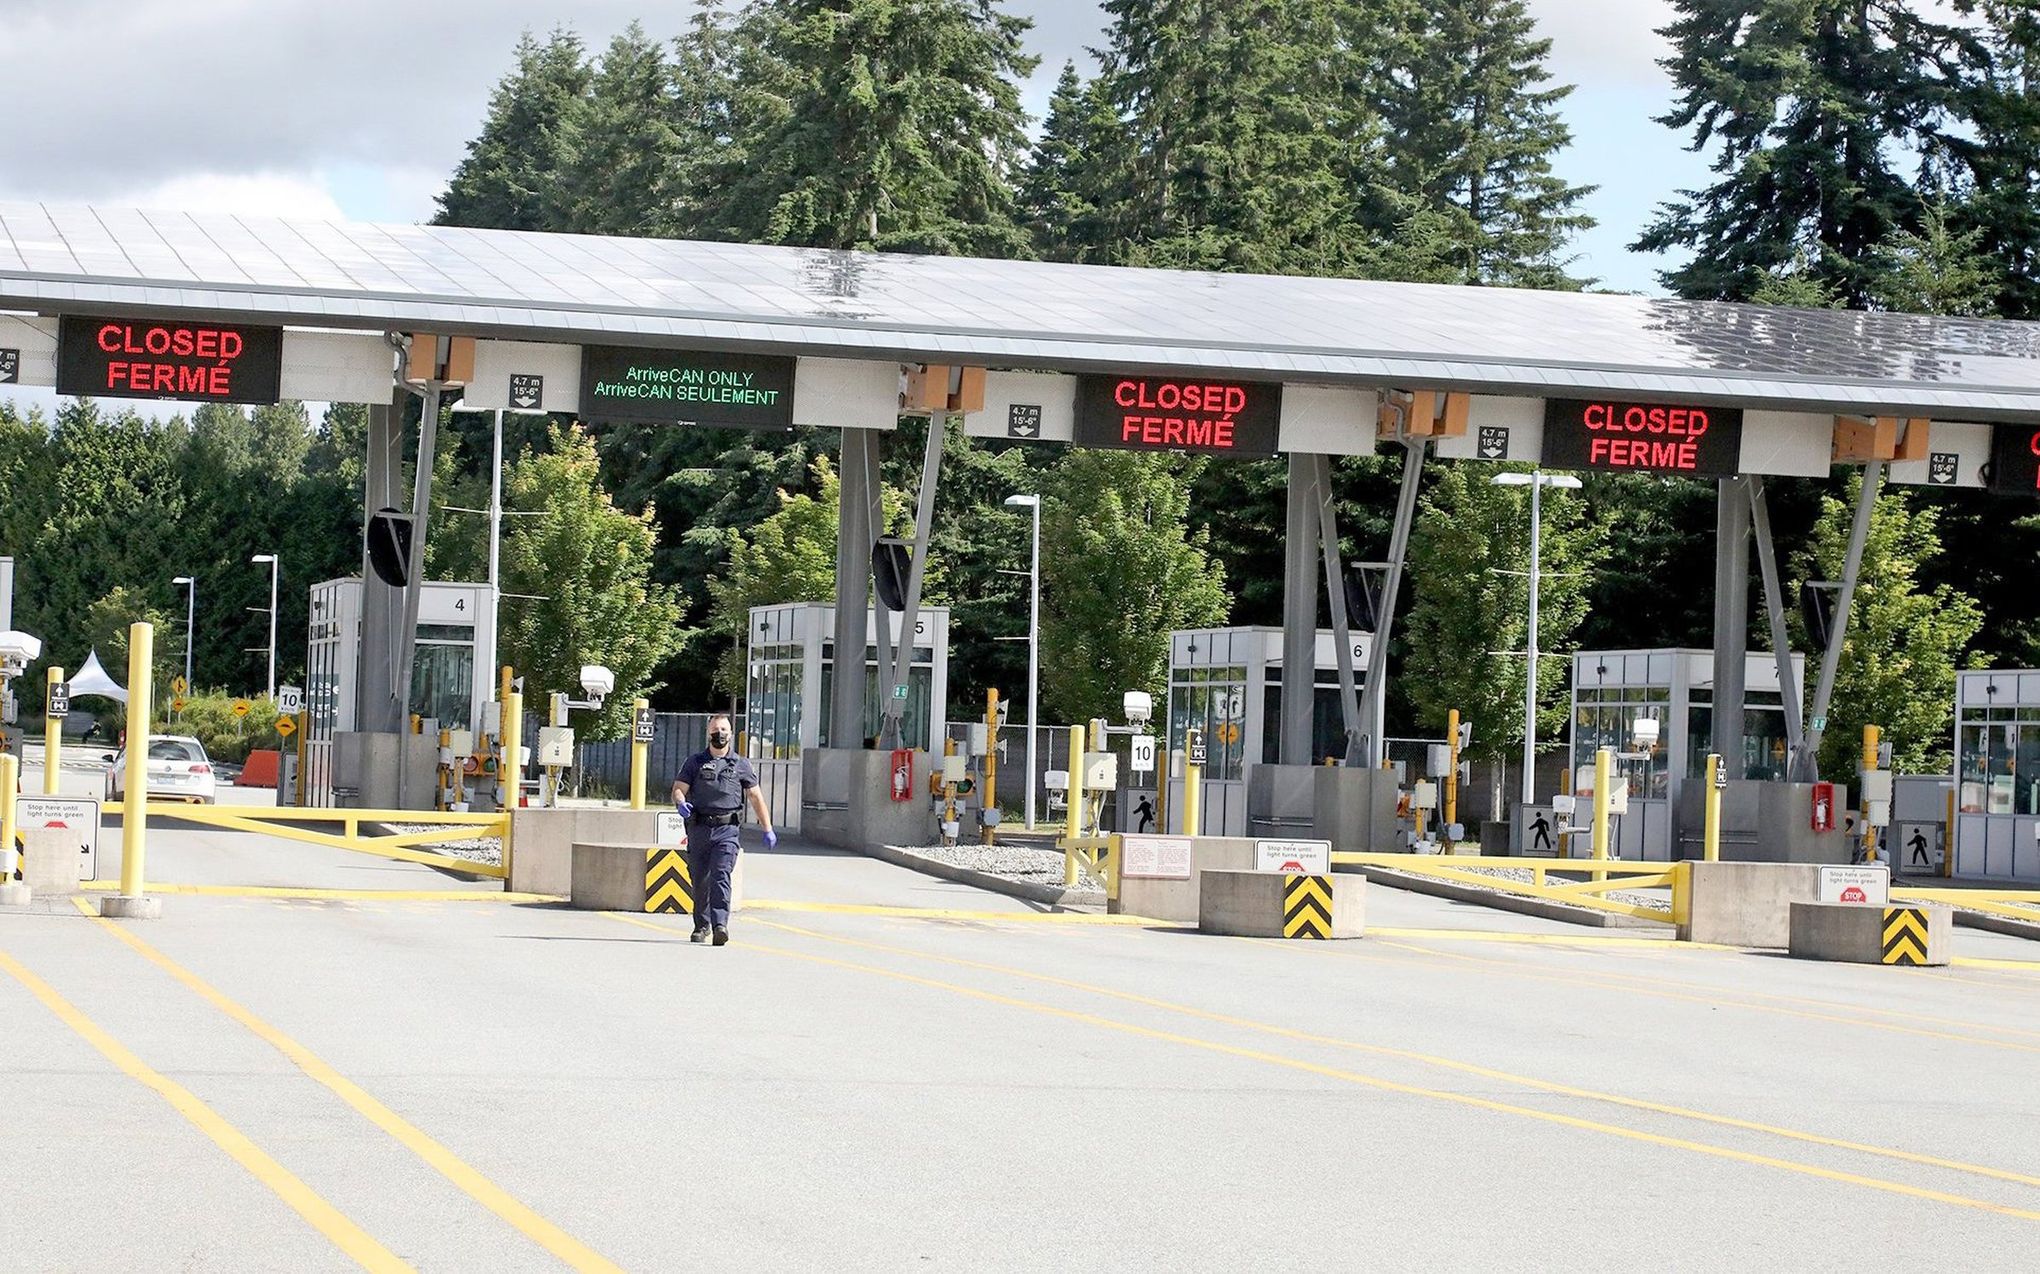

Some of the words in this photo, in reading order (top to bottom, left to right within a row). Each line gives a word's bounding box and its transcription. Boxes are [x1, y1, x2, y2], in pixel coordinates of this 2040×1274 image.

[98, 325, 242, 359] CLOSED
[107, 359, 231, 394] FERMÉ
[513, 376, 528, 386] 4.7
[626, 366, 703, 384] ArriveCAN
[708, 370, 754, 387] ONLY
[594, 381, 672, 400] ArriveCAN
[677, 385, 779, 405] SEULEMENT
[1115, 381, 1246, 414] CLOSED
[1012, 406, 1027, 415] 4.7
[1583, 404, 1709, 436] CLOSED
[1122, 413, 1234, 447] FERMÉ
[1482, 429, 1496, 437] 4.7
[1590, 435, 1699, 469] FERMÉ
[1932, 454, 1946, 463] 4.7
[455, 598, 465, 611] 4
[915, 621, 924, 634] 5
[1353, 644, 1363, 657] 6
[281, 693, 298, 707] 10
[1135, 745, 1151, 761] 10
[1844, 891, 1862, 900] STOP
